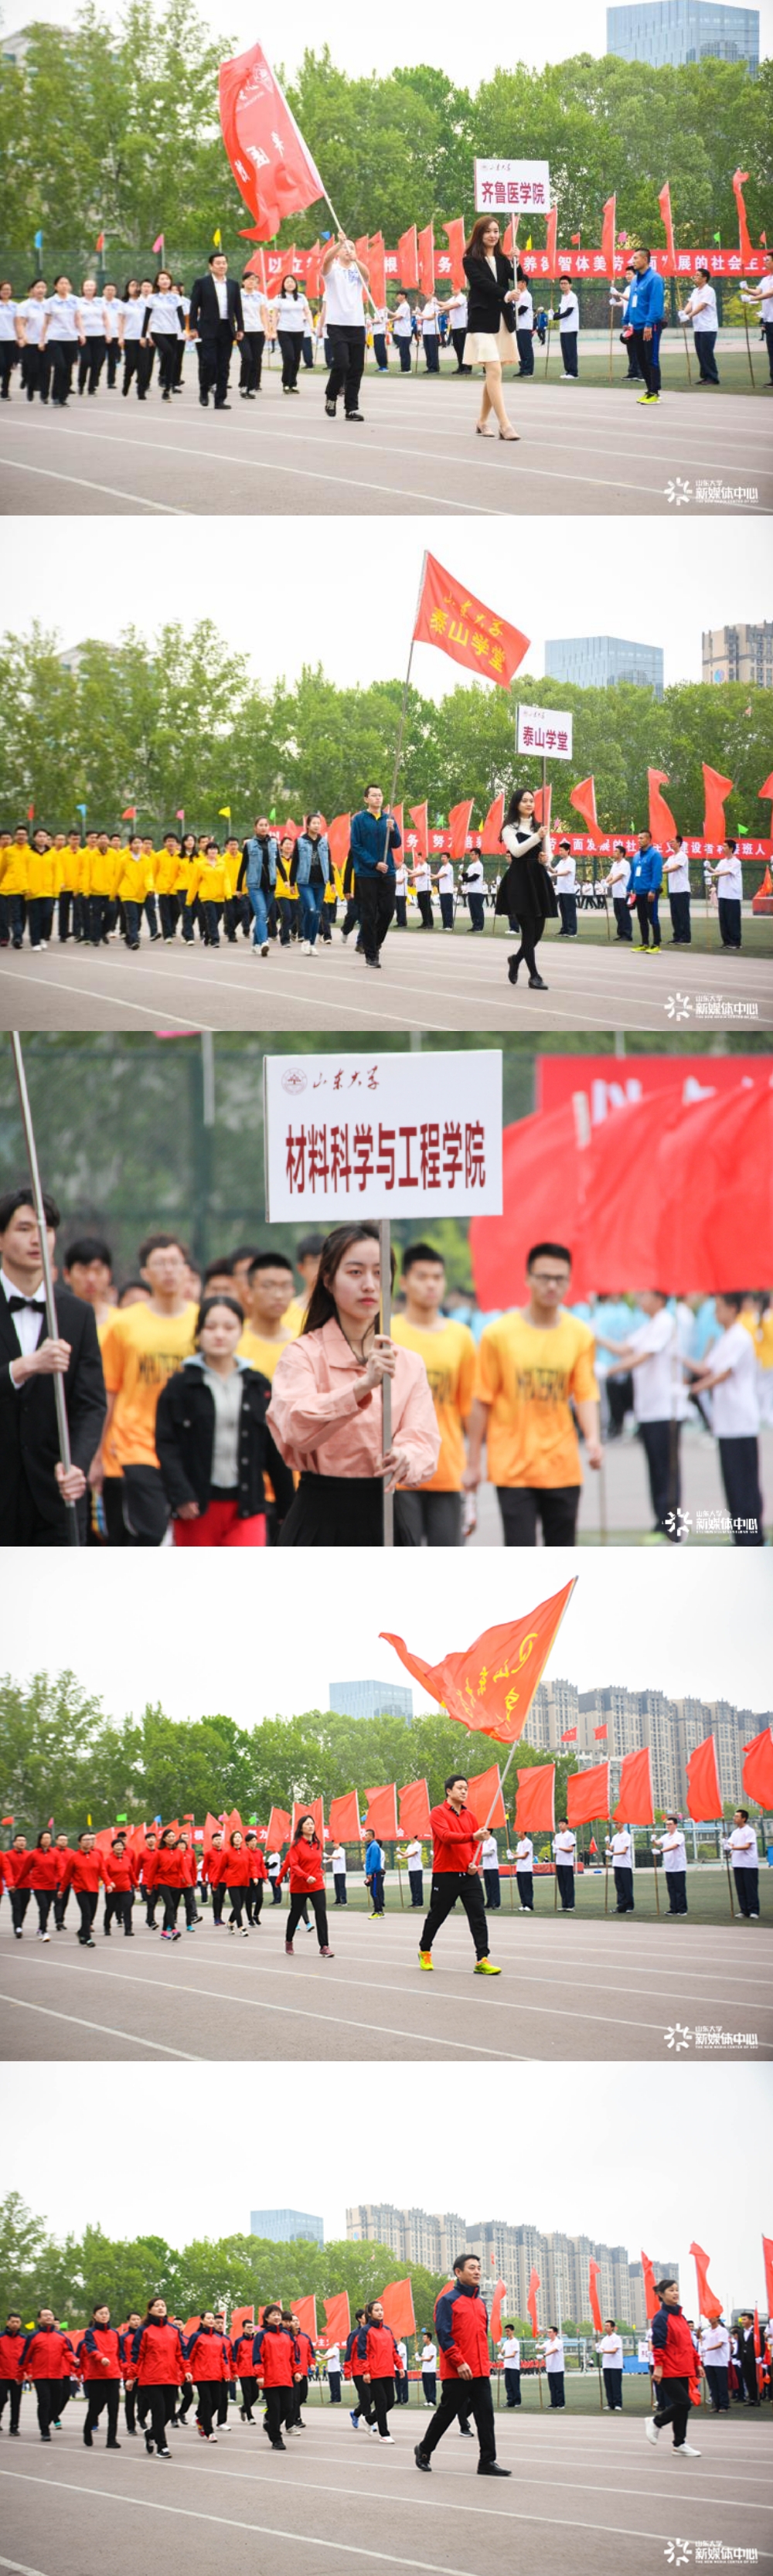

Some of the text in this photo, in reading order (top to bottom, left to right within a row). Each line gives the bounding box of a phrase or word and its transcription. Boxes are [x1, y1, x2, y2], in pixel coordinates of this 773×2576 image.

[482, 181, 545, 204] 齐鲁医学院
[430, 607, 506, 673] 泰山学堂
[523, 726, 568, 750] 泰山学堂
[286, 1120, 486, 1194] 材料科学与工程学院
